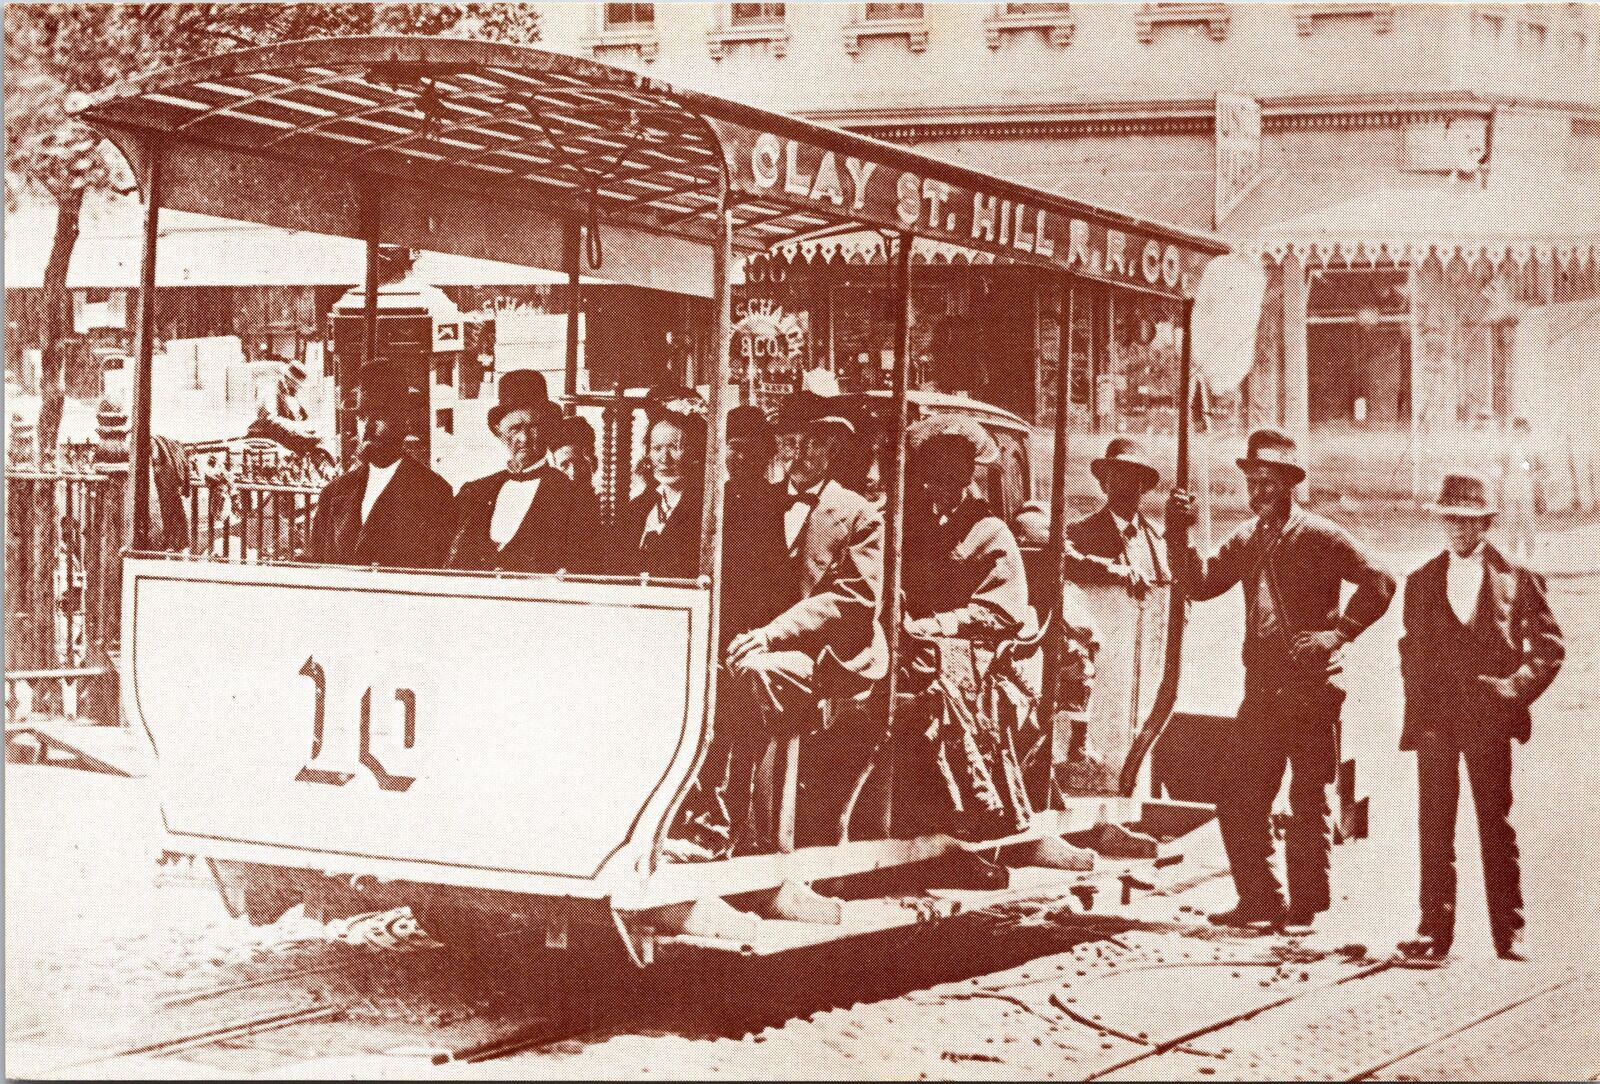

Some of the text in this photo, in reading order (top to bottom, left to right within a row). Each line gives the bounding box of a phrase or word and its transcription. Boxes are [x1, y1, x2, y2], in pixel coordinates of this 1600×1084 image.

[752, 132, 877, 209] CLAY
[897, 172, 956, 231] ST.
[971, 192, 1054, 258] HILL
[294, 654, 417, 793] 10
